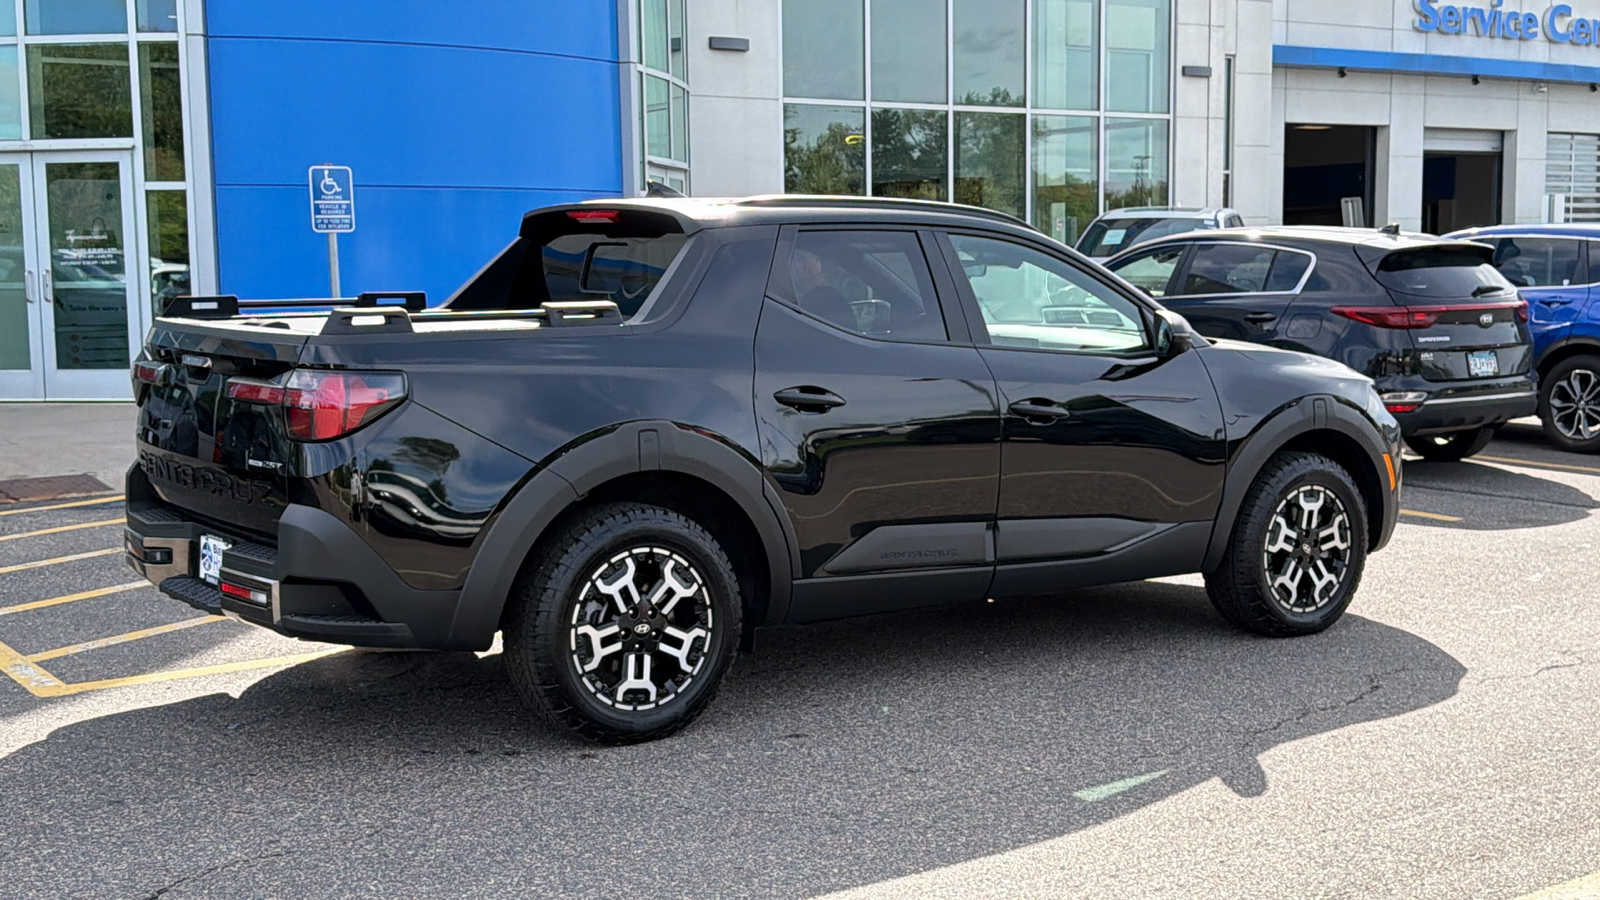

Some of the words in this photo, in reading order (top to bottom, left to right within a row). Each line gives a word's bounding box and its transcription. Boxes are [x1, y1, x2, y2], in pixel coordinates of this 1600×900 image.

[1414, 0, 1538, 40] Service
[139, 449, 197, 490] SANTA
[200, 467, 274, 507] CRUZ
